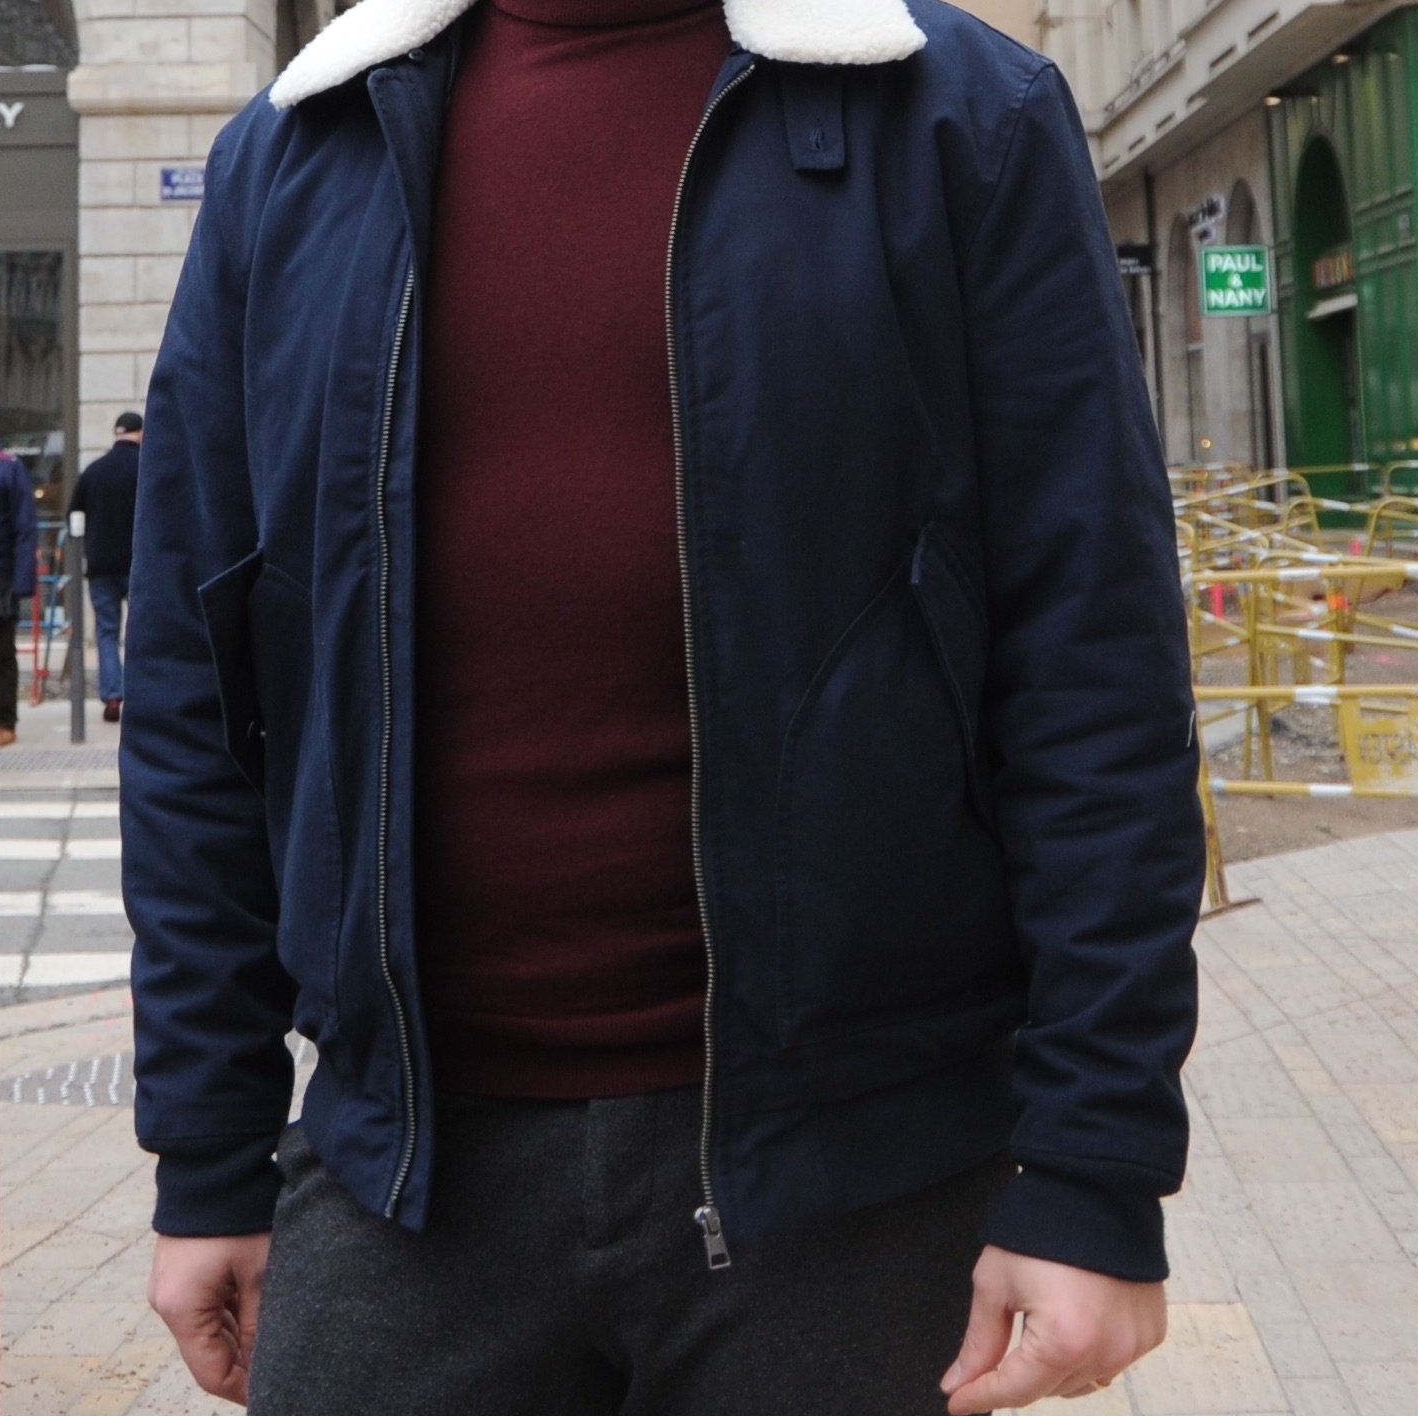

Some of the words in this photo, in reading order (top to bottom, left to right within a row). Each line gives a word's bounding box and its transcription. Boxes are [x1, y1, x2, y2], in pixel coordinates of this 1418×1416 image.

[1207, 253, 1264, 274] PAUL
[1228, 273, 1244, 289] &
[1208, 288, 1266, 309] NANY
